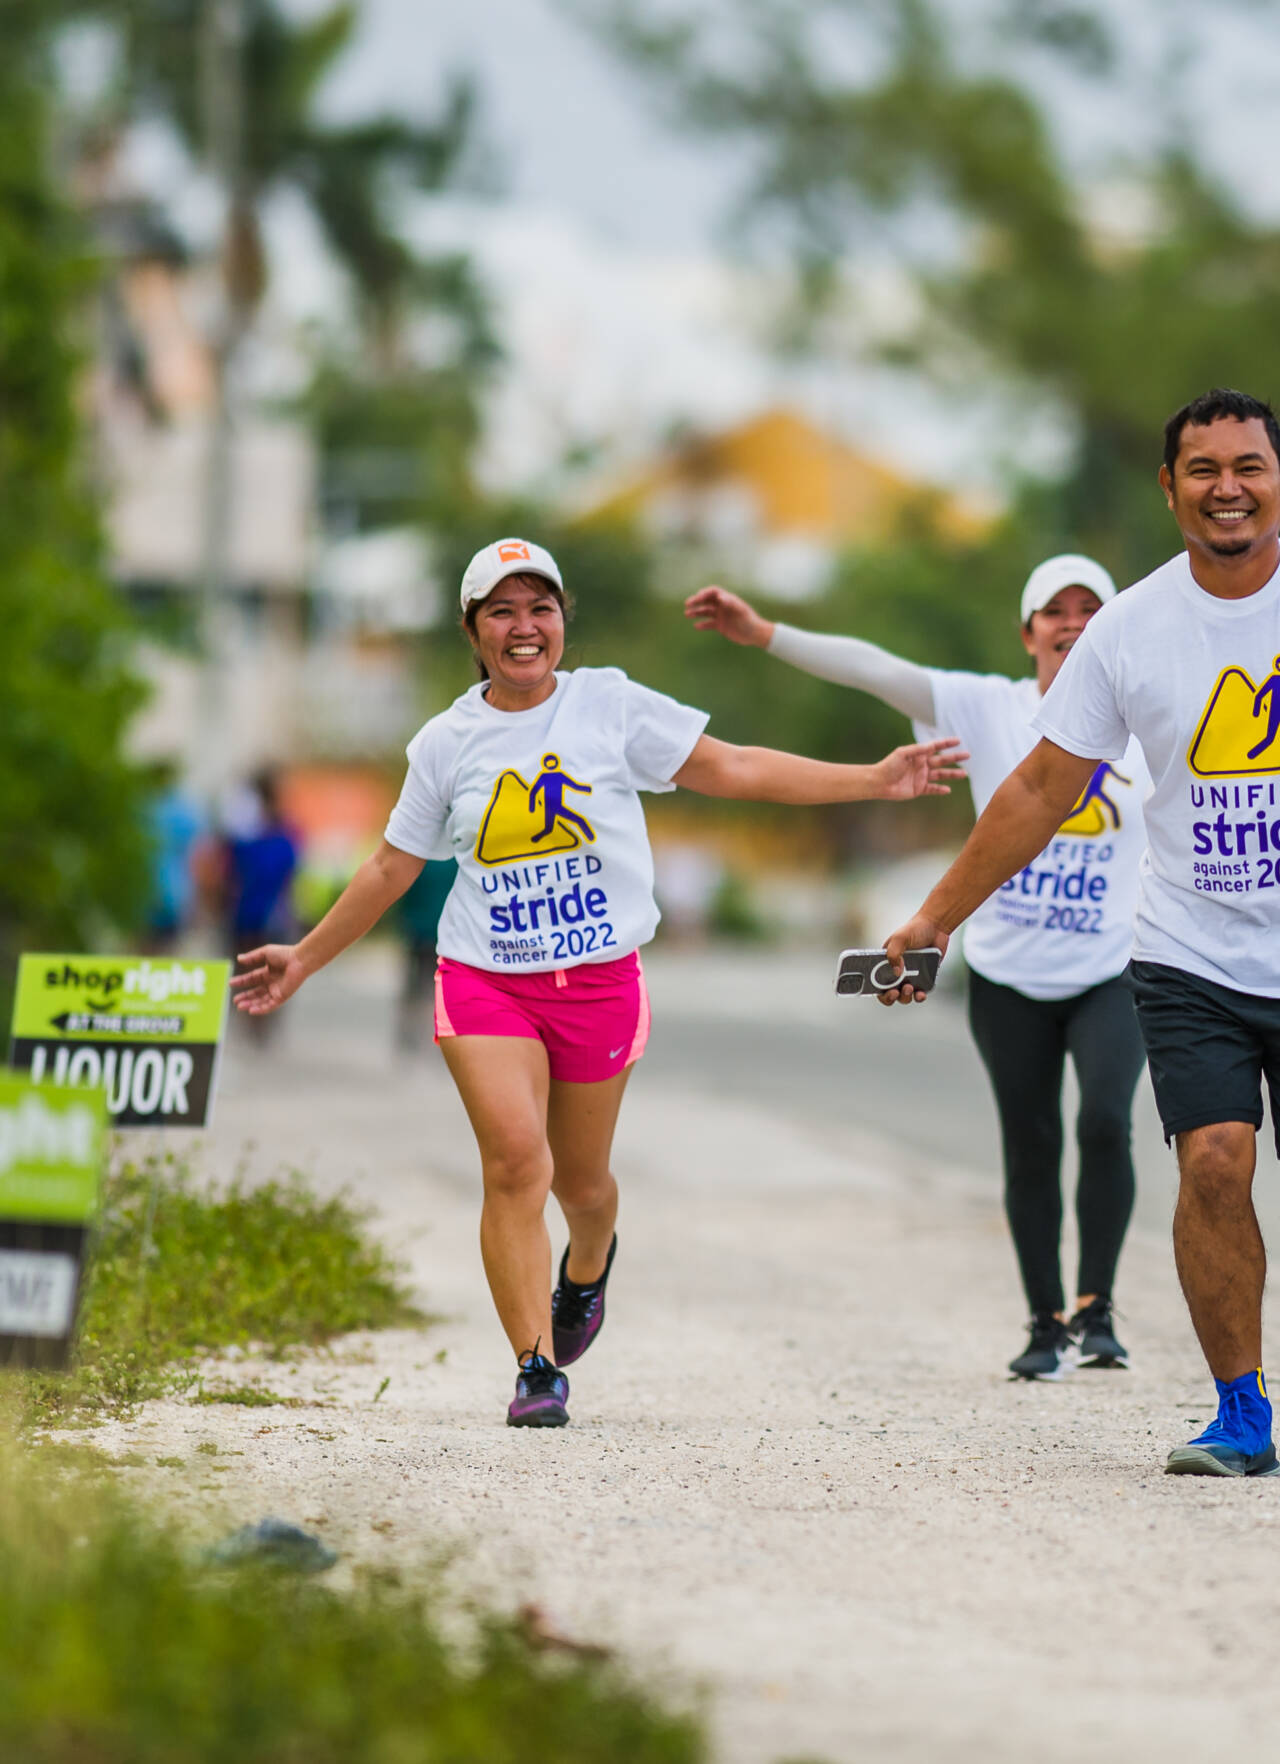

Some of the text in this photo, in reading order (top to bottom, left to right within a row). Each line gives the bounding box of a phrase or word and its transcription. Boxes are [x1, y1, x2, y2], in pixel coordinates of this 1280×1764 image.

[1042, 842, 1114, 863] IFIED
[482, 855, 602, 894] UNIFIED
[1193, 860, 1251, 878] against
[1194, 877, 1252, 892] cancer
[490, 882, 608, 933] stride
[1044, 904, 1104, 934] 2022
[490, 934, 545, 951] against
[550, 922, 617, 960] 2022
[493, 950, 548, 964] cancer
